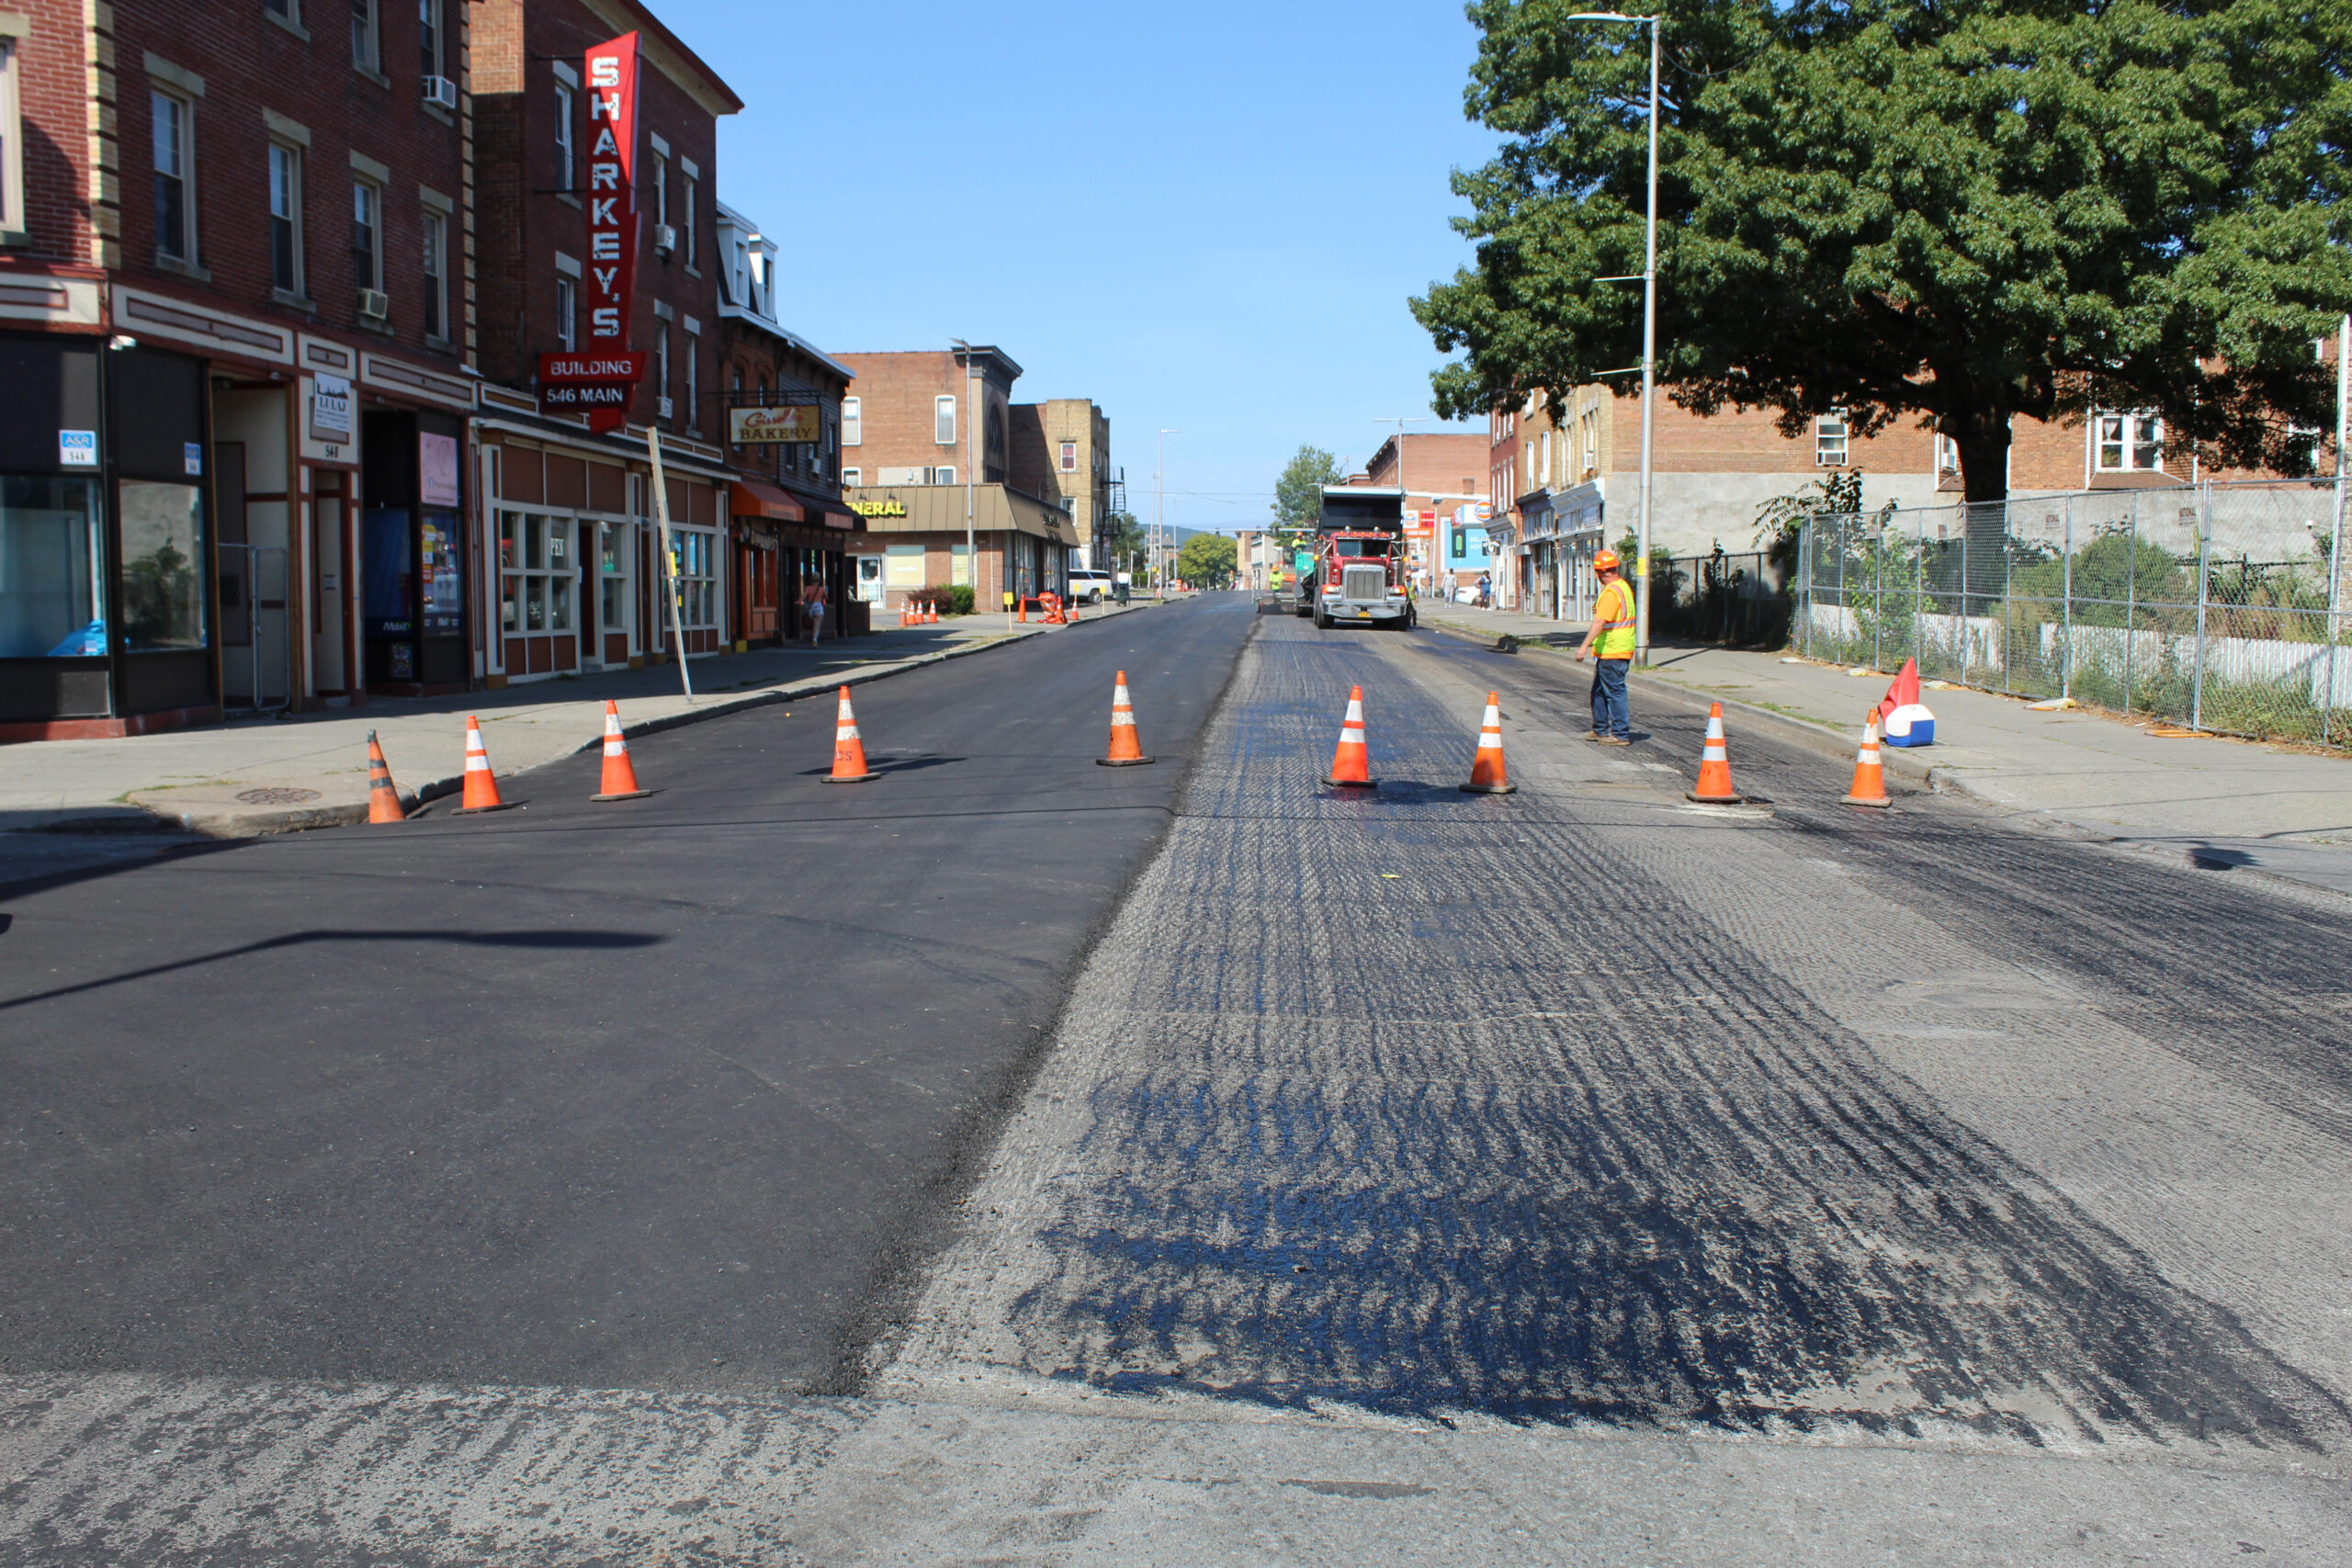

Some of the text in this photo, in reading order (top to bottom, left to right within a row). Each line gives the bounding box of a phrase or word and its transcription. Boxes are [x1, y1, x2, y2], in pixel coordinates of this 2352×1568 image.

[591, 56, 620, 337] SHARKEY'S
[551, 360, 632, 376] BUILDING
[547, 388, 623, 402] 546 MAIN
[64, 436, 90, 446] A&R
[741, 428, 812, 439] BAKERY
[551, 538, 564, 557] PEN
